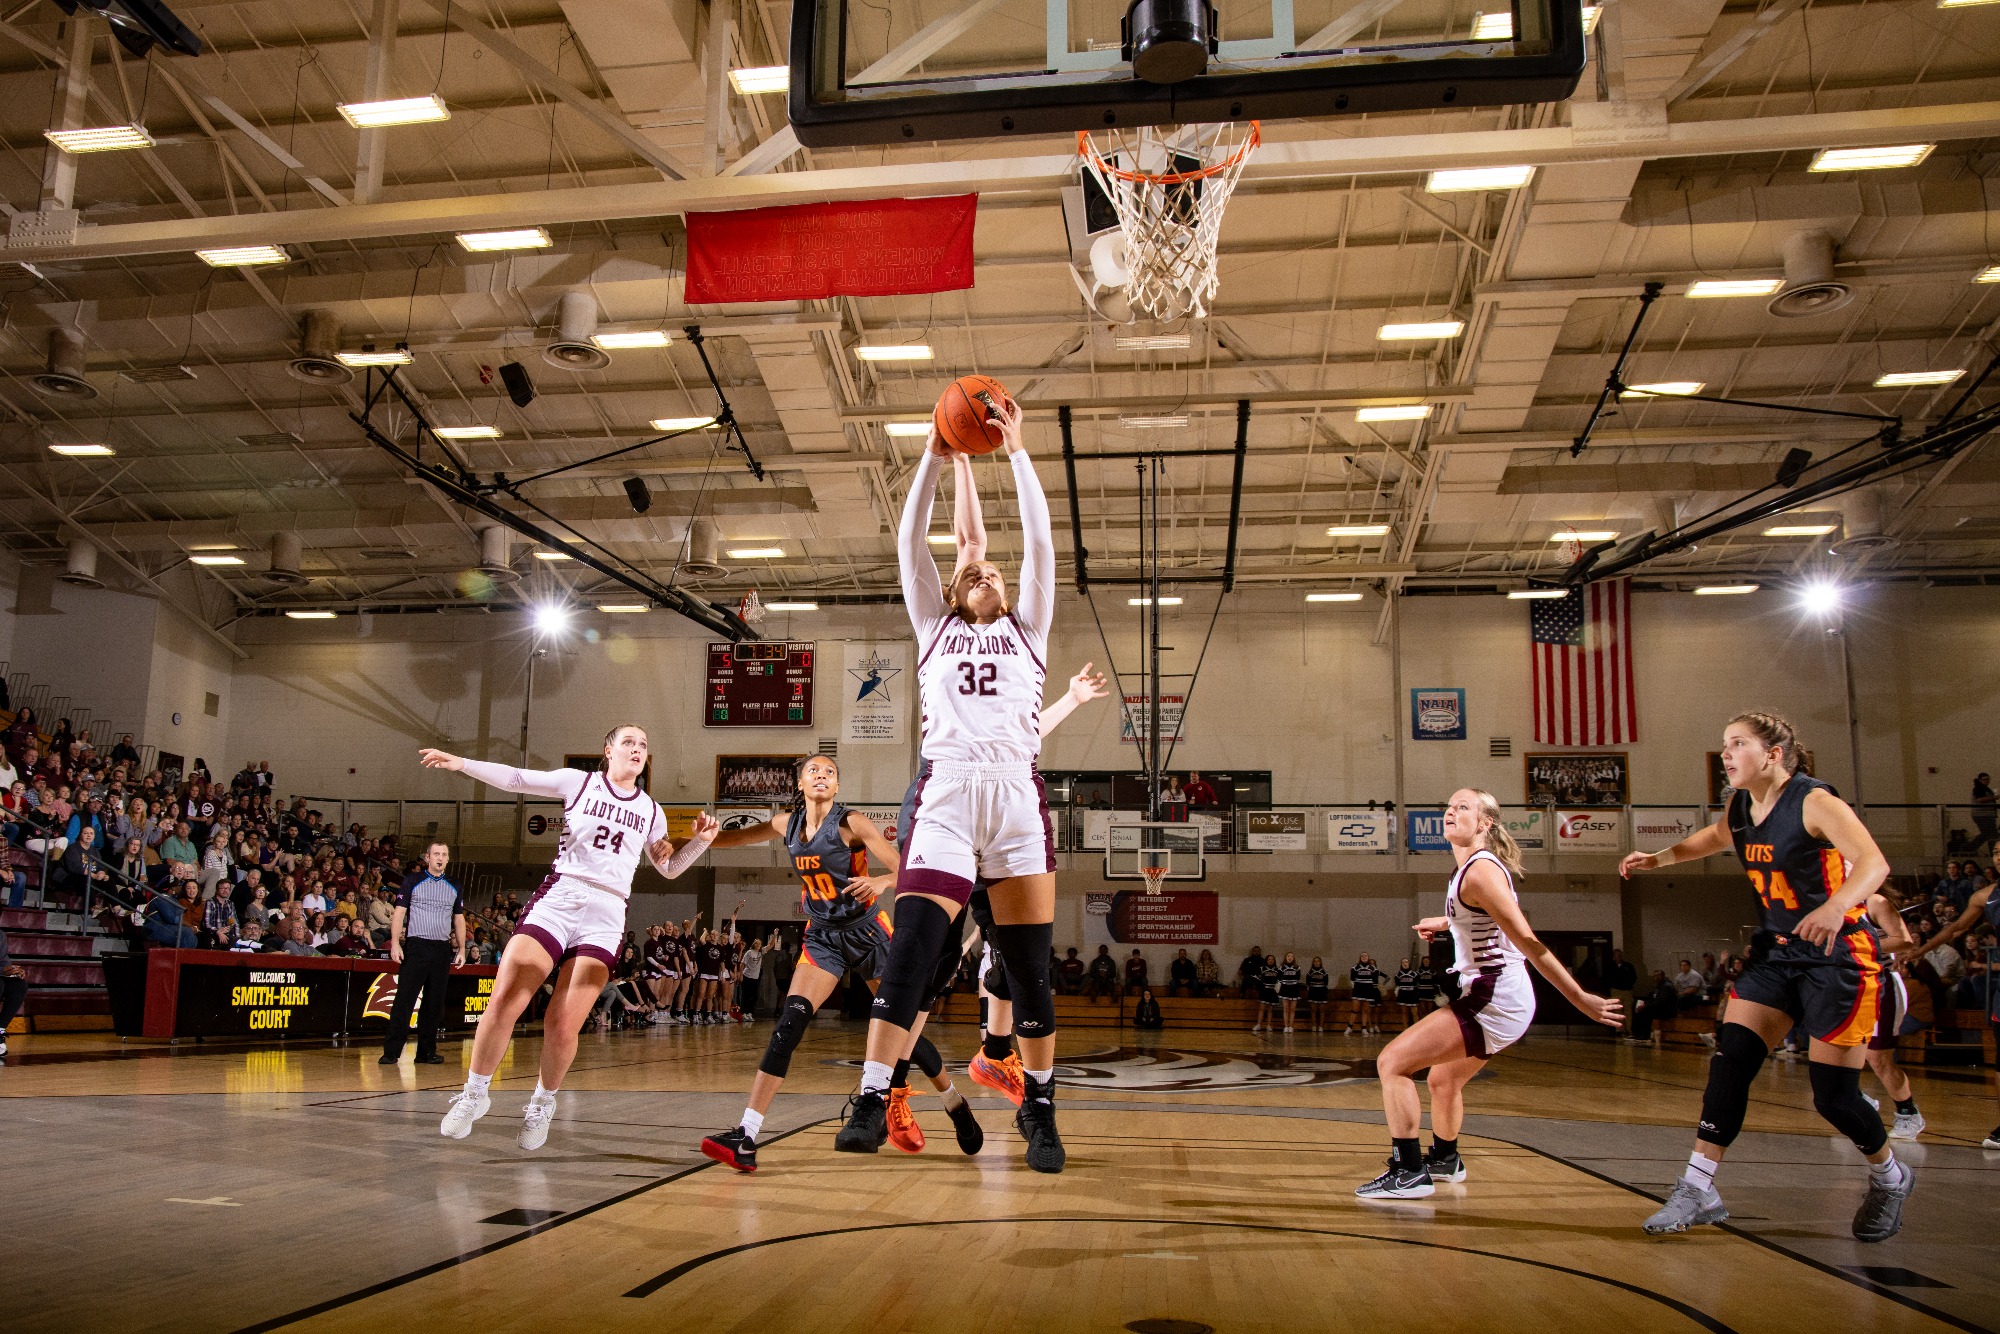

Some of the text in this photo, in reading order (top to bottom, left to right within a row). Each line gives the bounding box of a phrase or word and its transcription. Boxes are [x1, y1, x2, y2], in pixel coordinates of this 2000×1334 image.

[788, 643, 814, 651] VISITOR
[977, 635, 1018, 656] LIONS
[722, 653, 731, 667] 5
[802, 652, 811, 667] 0
[958, 661, 998, 695] 32
[716, 684, 725, 695] 4
[795, 683, 803, 695] 3
[1420, 699, 1456, 711] NAIA
[583, 798, 646, 834] LADY LIONS
[1252, 816, 1267, 825] no
[1415, 817, 1444, 834] MT
[1571, 822, 1616, 831] CASEY
[1637, 826, 1683, 834] SNOOKUM'S
[593, 825, 624, 854] 24
[1745, 844, 1775, 863] UTS
[795, 856, 821, 870] UTS
[801, 873, 838, 901] 10
[1746, 869, 1800, 910] 24
[250, 972, 296, 984] WELCOME TO
[232, 987, 309, 1006] SMITH-KIRK
[249, 1010, 291, 1030] COURT
